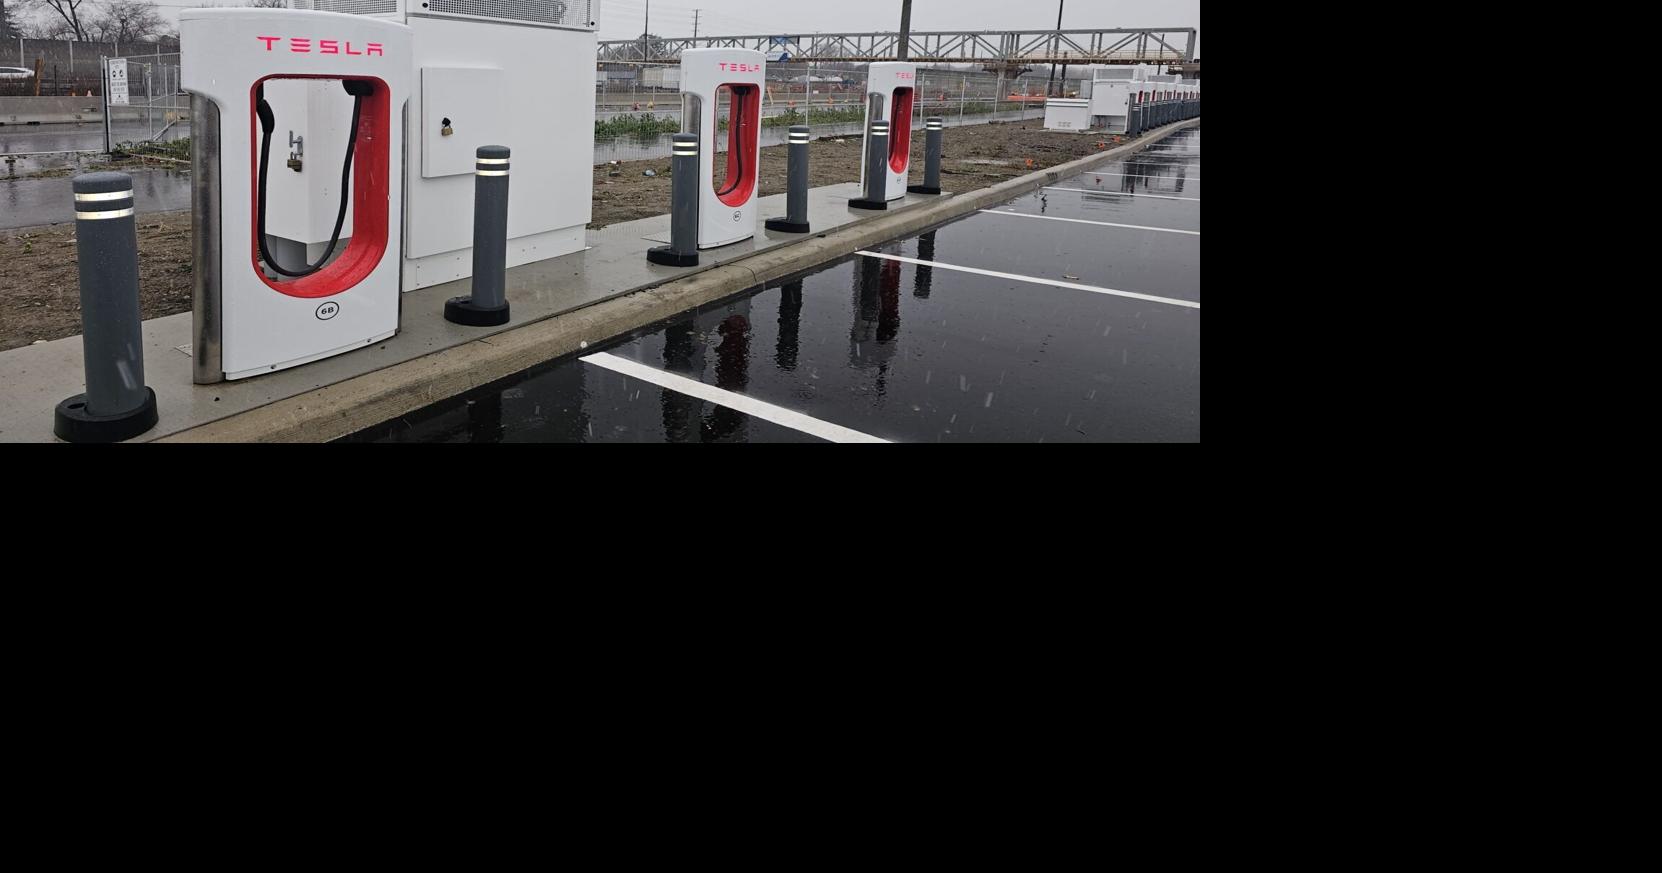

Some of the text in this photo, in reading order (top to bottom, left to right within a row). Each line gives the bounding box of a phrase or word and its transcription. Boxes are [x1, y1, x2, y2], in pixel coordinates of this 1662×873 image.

[256, 36, 383, 56] TESLA
[719, 63, 760, 72] TESLA
[321, 306, 334, 315] 6B
